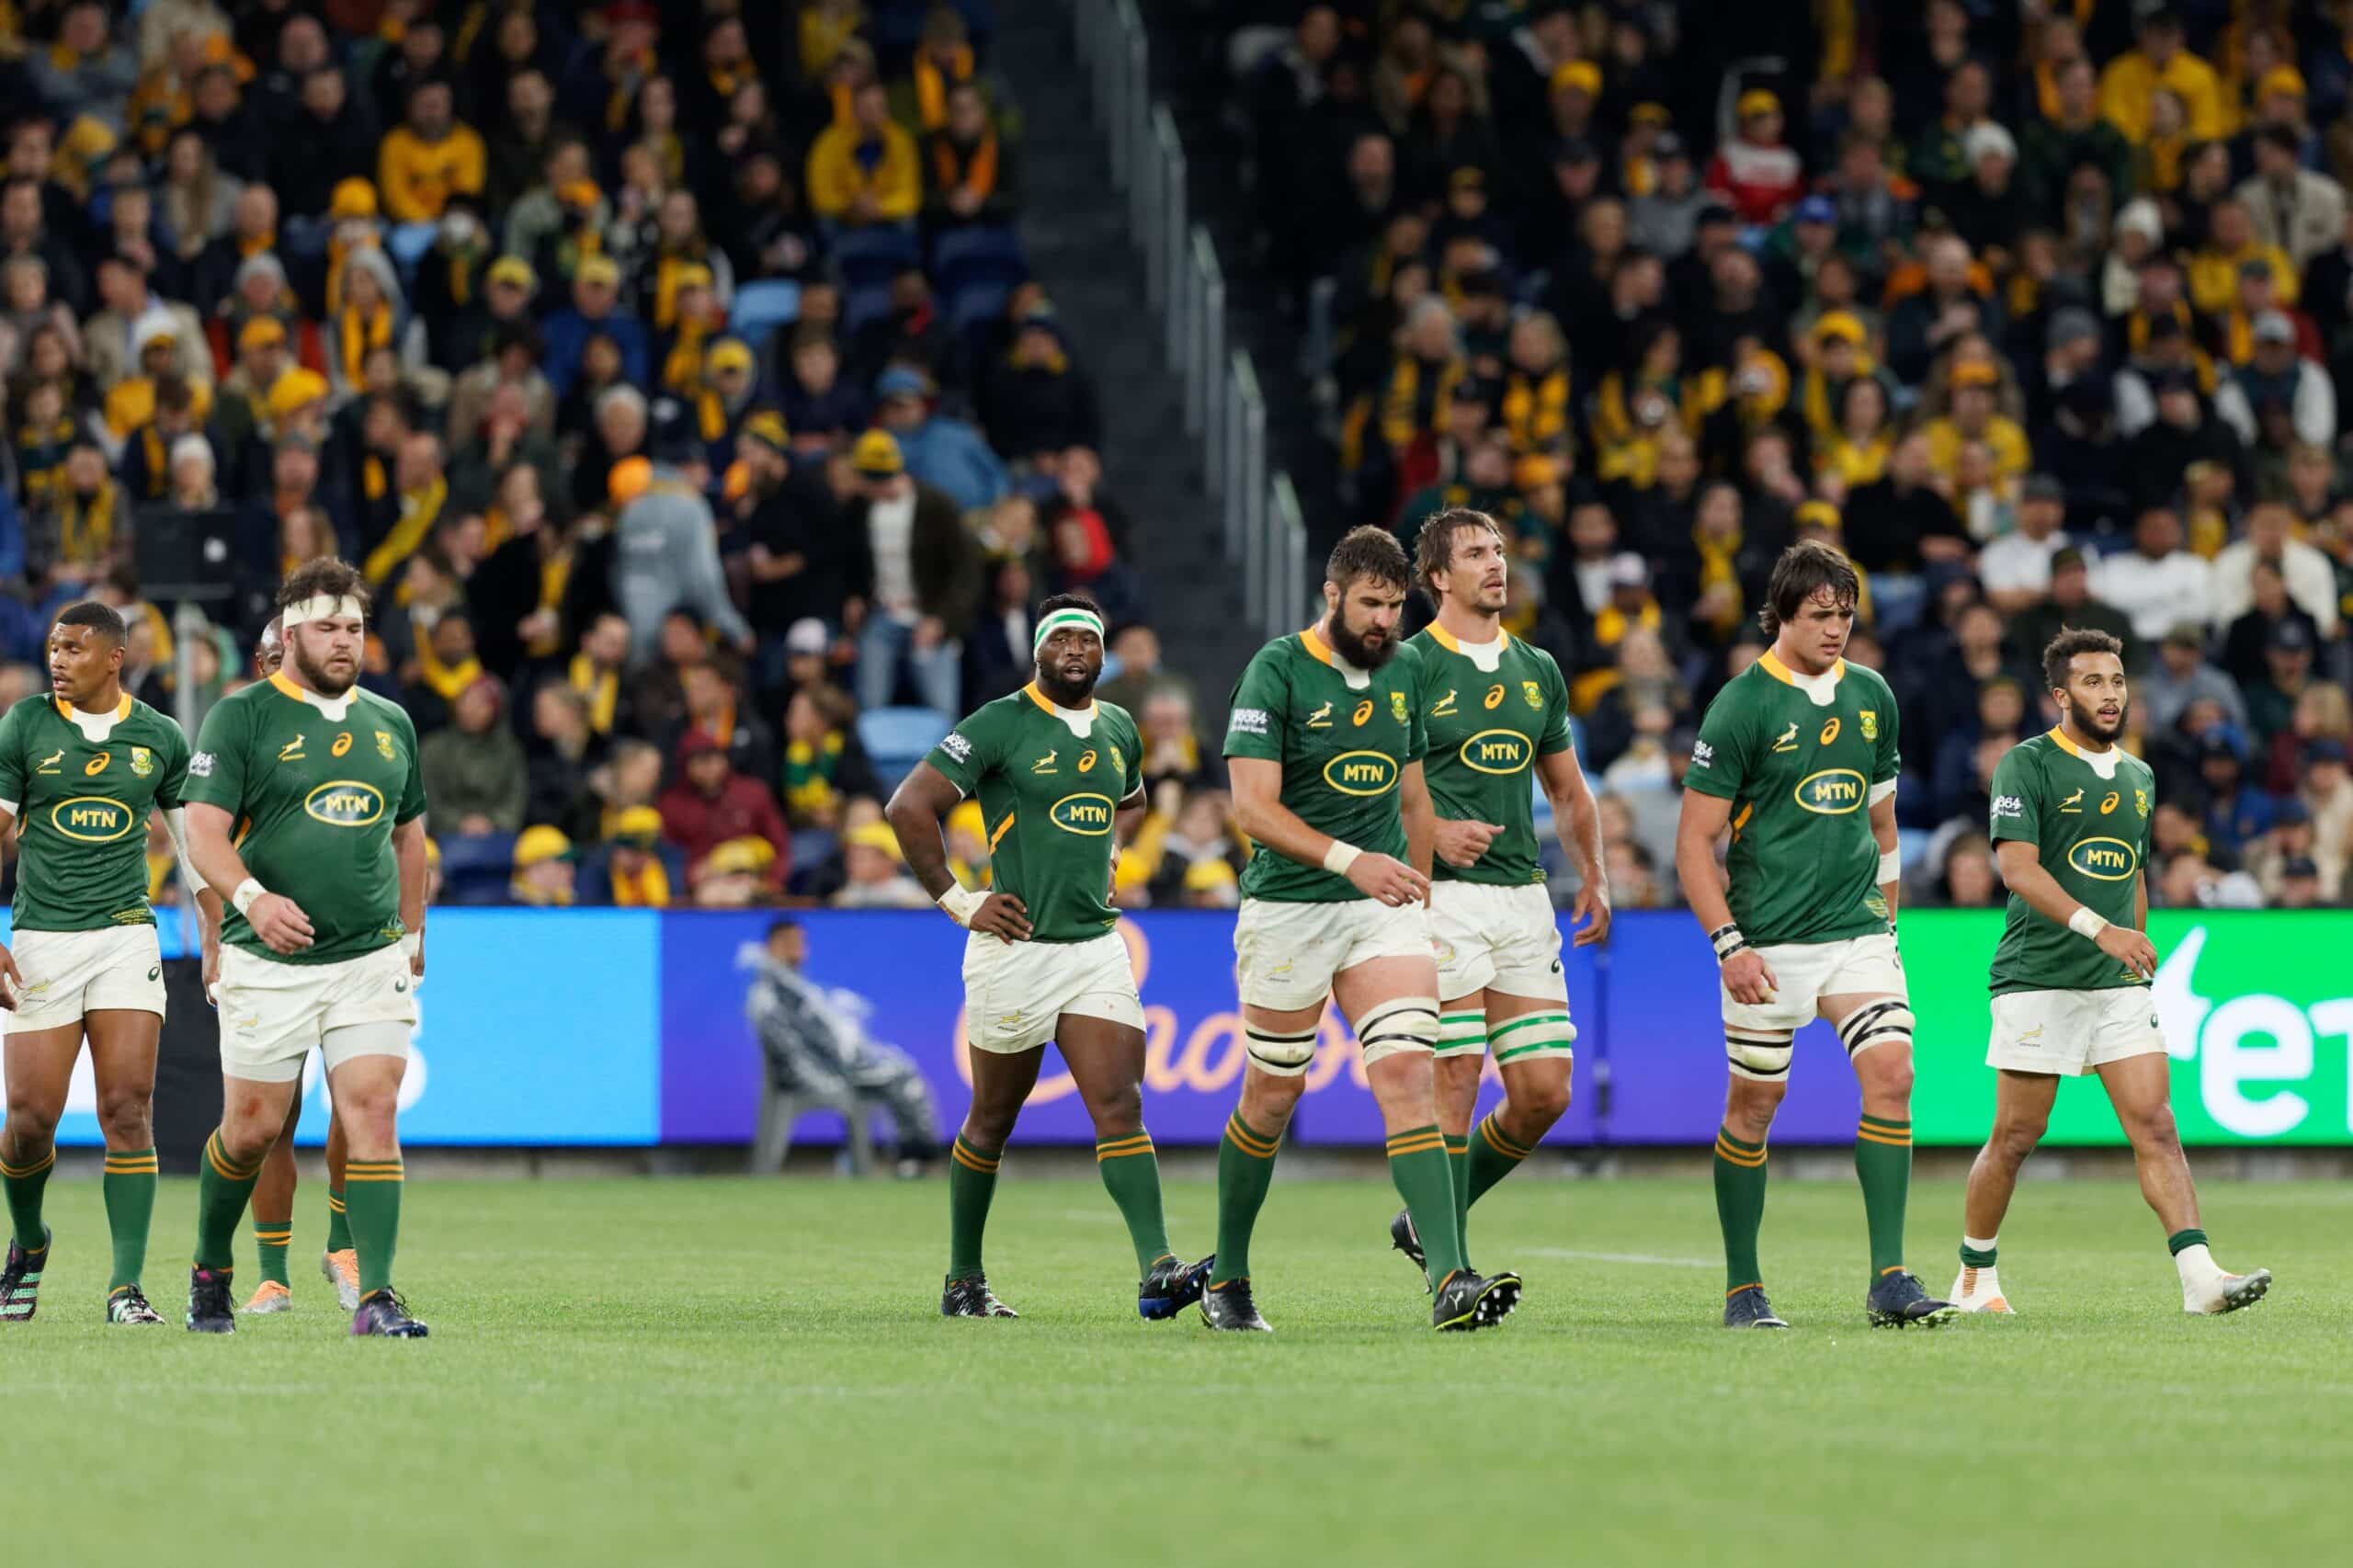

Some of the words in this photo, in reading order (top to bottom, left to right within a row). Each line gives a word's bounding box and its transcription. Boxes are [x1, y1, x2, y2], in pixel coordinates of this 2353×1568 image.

[1481, 743, 1519, 761] MTN
[1343, 764, 1384, 782] MTN
[1814, 782, 1857, 801] MTN
[324, 794, 369, 812] MTN
[71, 809, 117, 828] MTN
[1070, 805, 1107, 824] MTN
[2086, 849, 2125, 869] MTN
